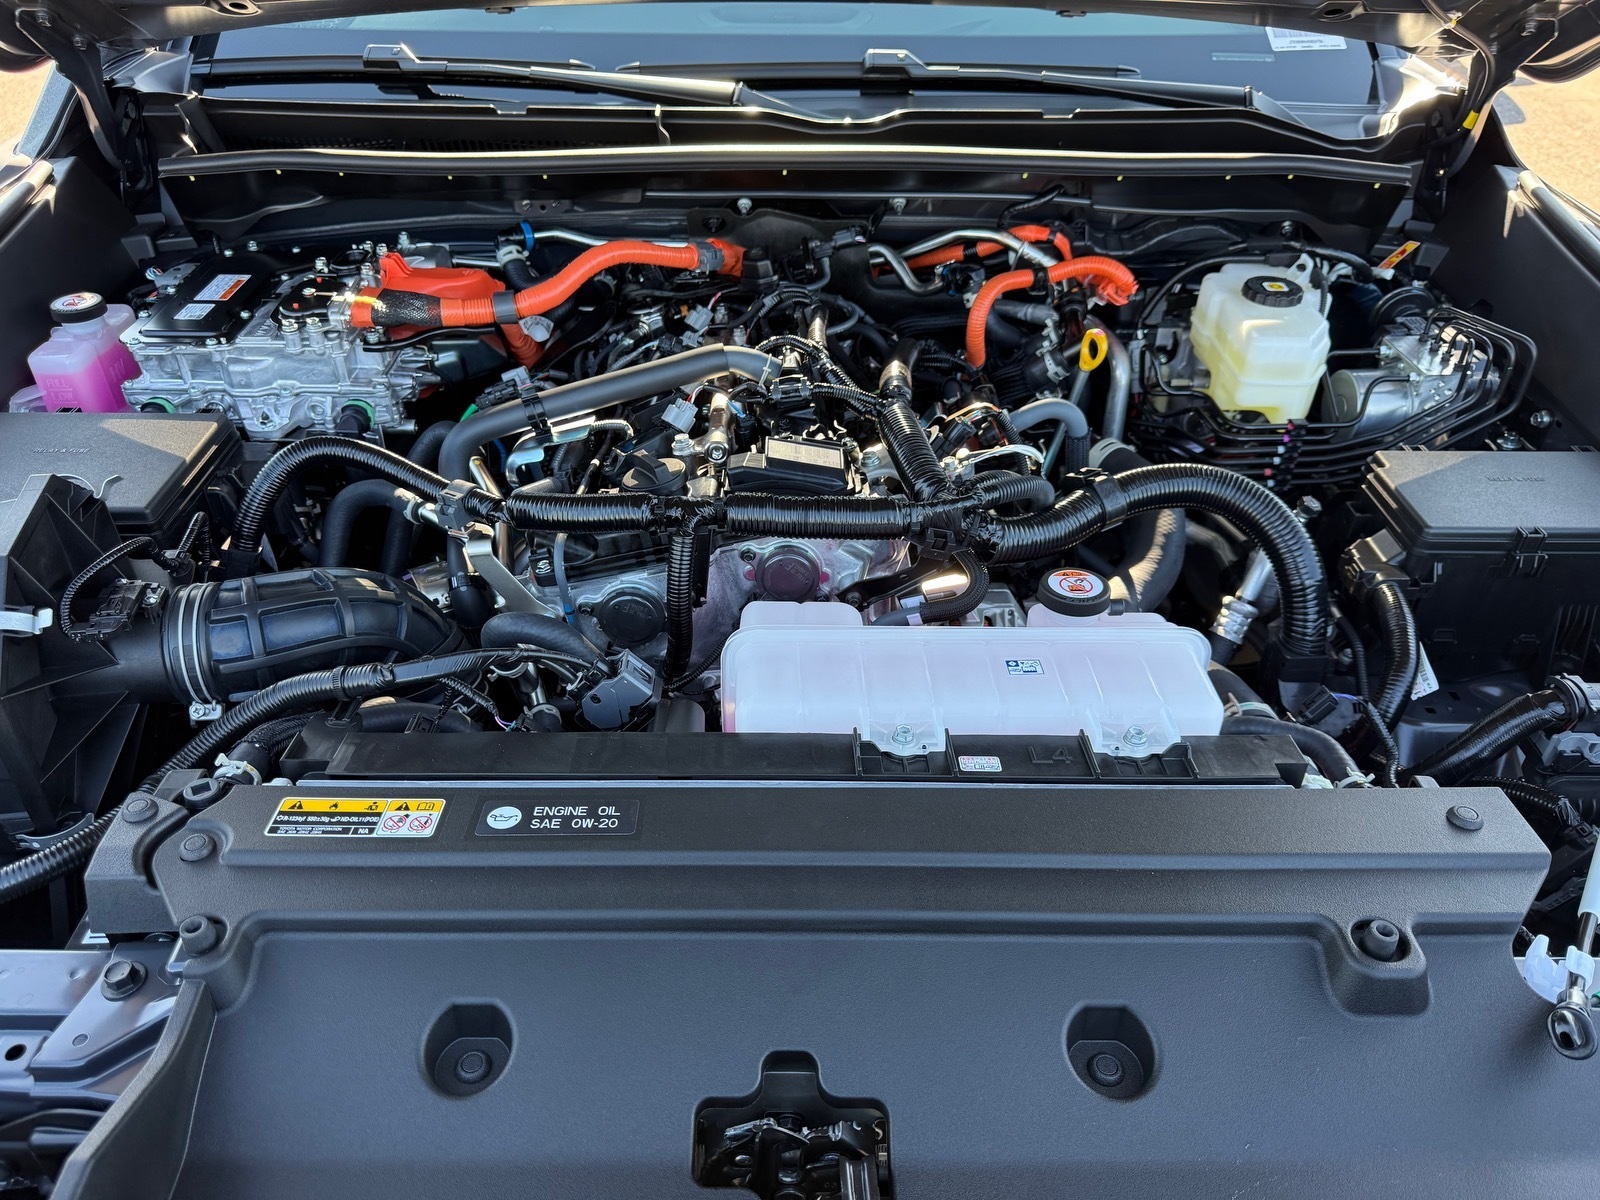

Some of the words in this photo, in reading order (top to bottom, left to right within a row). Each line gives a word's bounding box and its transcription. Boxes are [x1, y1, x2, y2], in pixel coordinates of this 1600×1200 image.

[45, 378, 70, 389] FULL
[50, 391, 74, 401] LOW
[1027, 745, 1073, 764] L4
[533, 806, 588, 816] ENGINE
[598, 806, 621, 816] OIL
[530, 818, 561, 829] SAE
[571, 818, 619, 829] 0W-20
